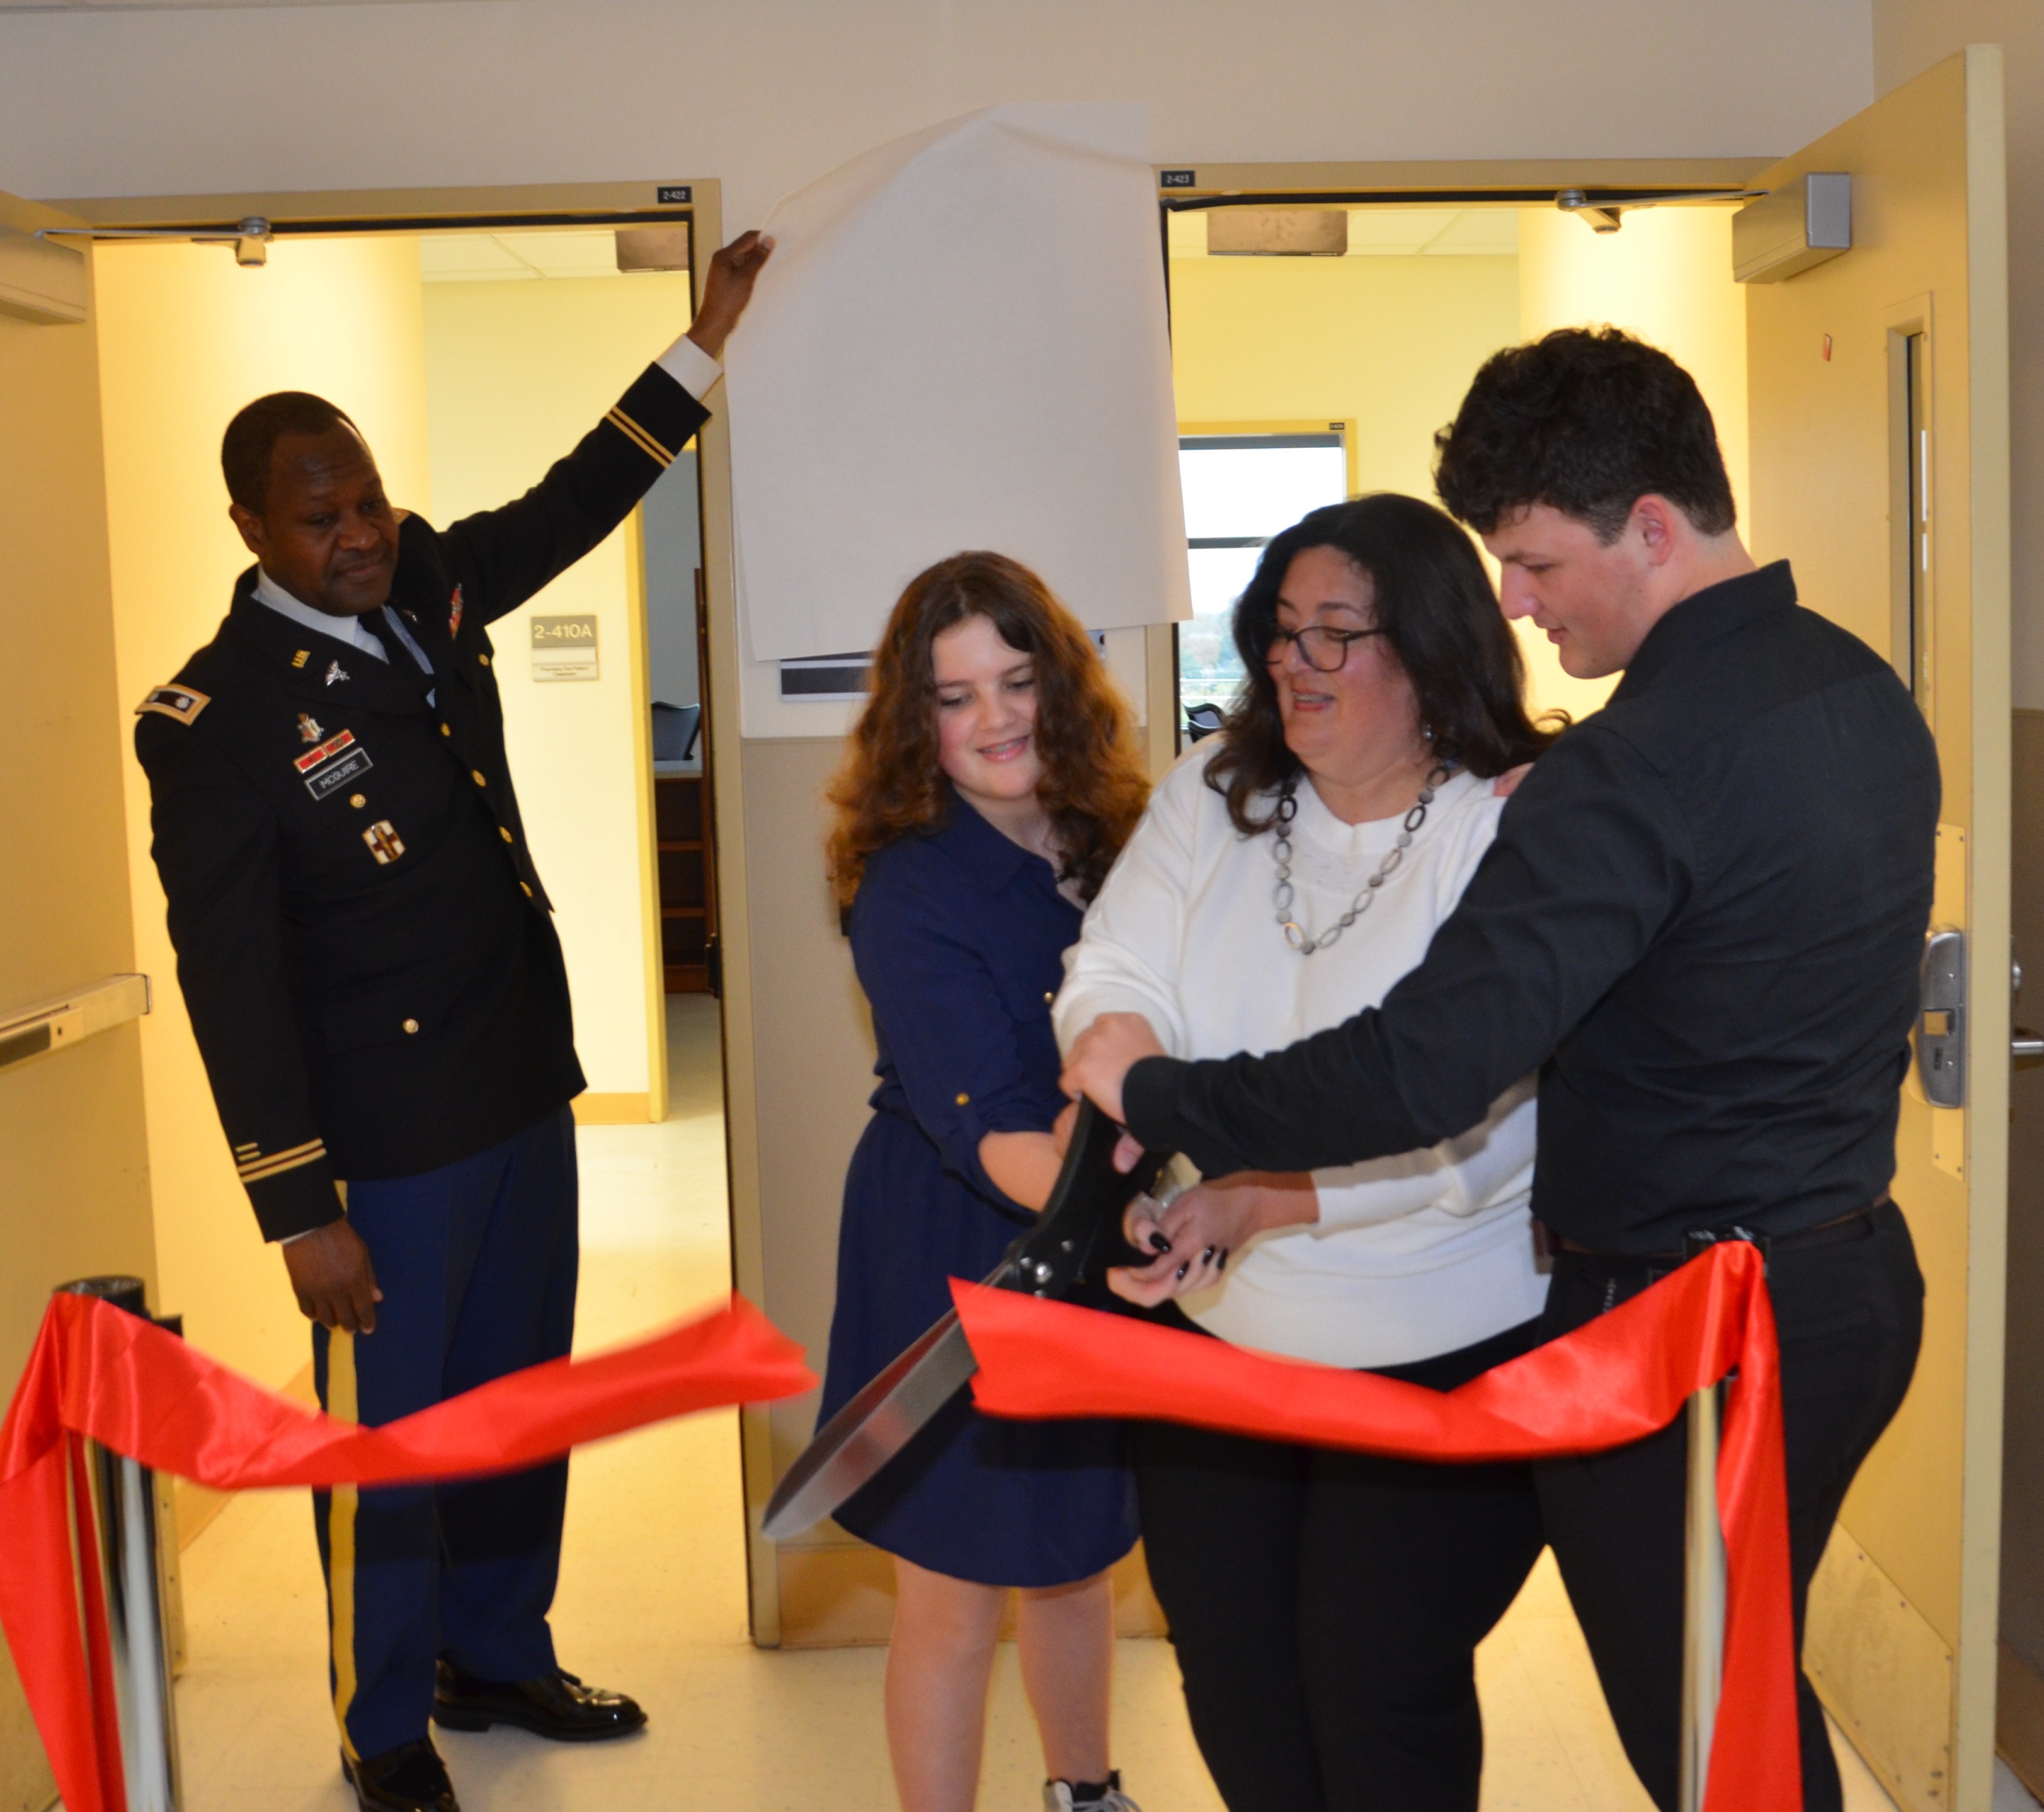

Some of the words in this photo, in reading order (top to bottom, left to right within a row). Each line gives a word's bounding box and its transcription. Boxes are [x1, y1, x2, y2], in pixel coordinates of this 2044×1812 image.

[1167, 174, 1189, 183] 2-423
[663, 191, 686, 200] 2-422
[534, 624, 592, 639] 2-410A
[320, 760, 360, 789] MCGUIRE
